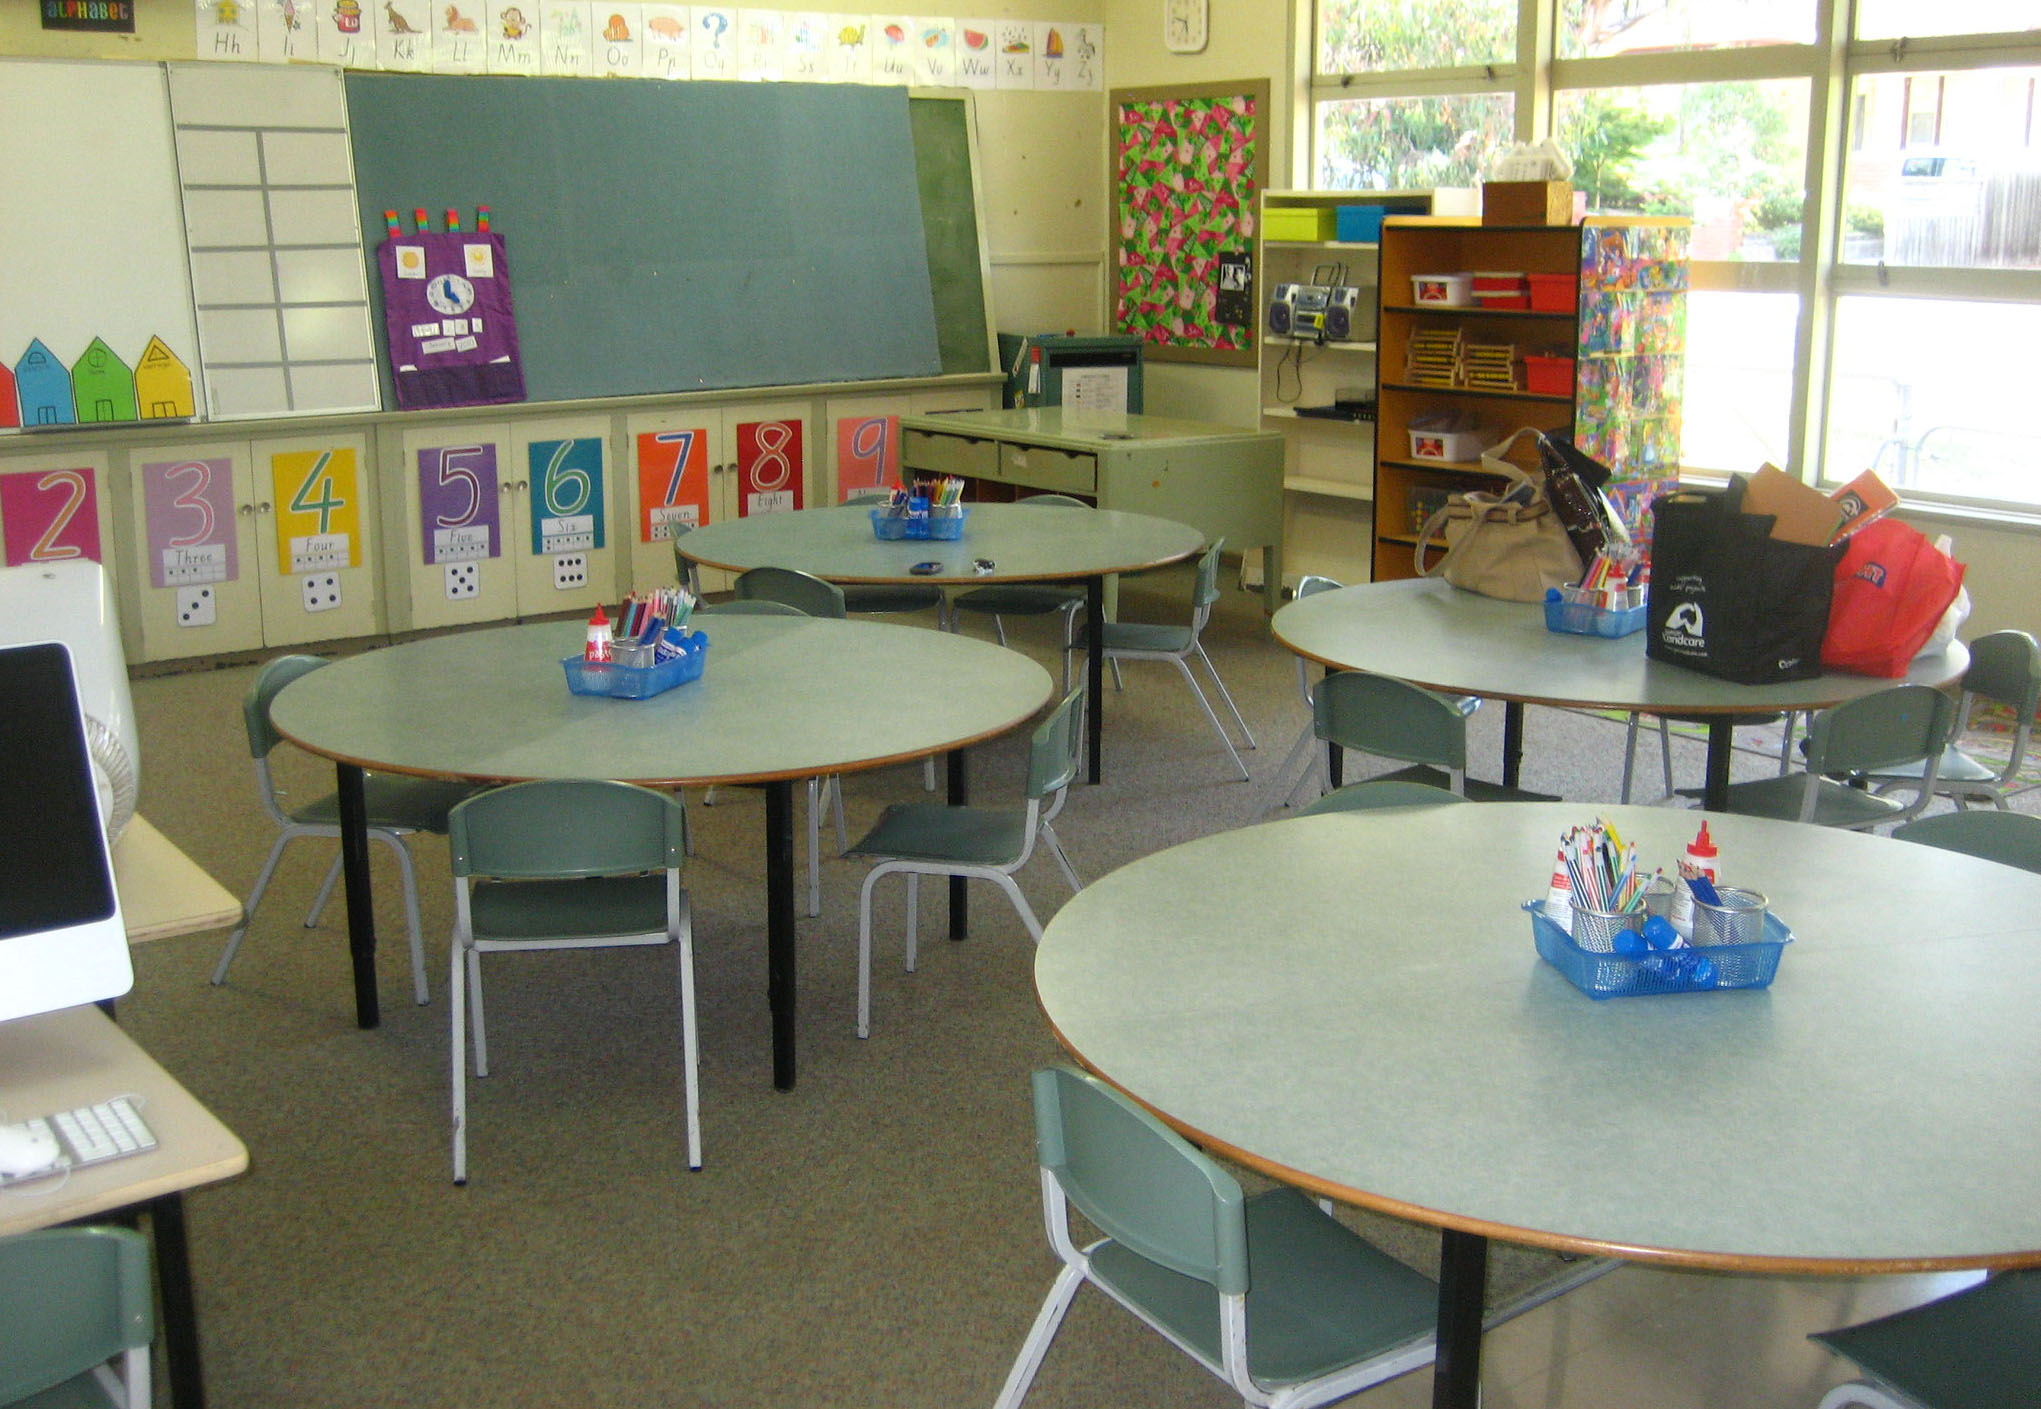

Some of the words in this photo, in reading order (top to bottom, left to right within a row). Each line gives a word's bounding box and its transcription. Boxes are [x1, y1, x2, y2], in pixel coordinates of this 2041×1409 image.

[214, 32, 240, 54] Hh
[393, 39, 414, 60] Kk
[453, 42, 467, 62] Ll
[497, 43, 531, 64] Mm
[554, 45, 580, 65] Nn
[606, 47, 629, 66] Oo
[657, 48, 676, 75] Pp
[884, 58, 904, 74] Uu
[927, 58, 943, 74] Vv
[963, 58, 990, 75] Ww
[1007, 59, 1023, 76] Xx
[1044, 61, 1061, 83] Yy
[750, 420, 793, 493] 8
[852, 416, 887, 487] 9
[545, 439, 590, 517] 6
[655, 431, 694, 507] 7
[290, 450, 345, 535] 4
[436, 445, 483, 528] 5
[165, 461, 214, 547] 3
[757, 493, 783, 510] Eight
[30, 471, 86, 560] 2
[660, 507, 690, 521] Seven
[449, 529, 473, 543] Five
[558, 520, 576, 533] Six
[305, 537, 335, 553] Four
[175, 549, 213, 566] Three
